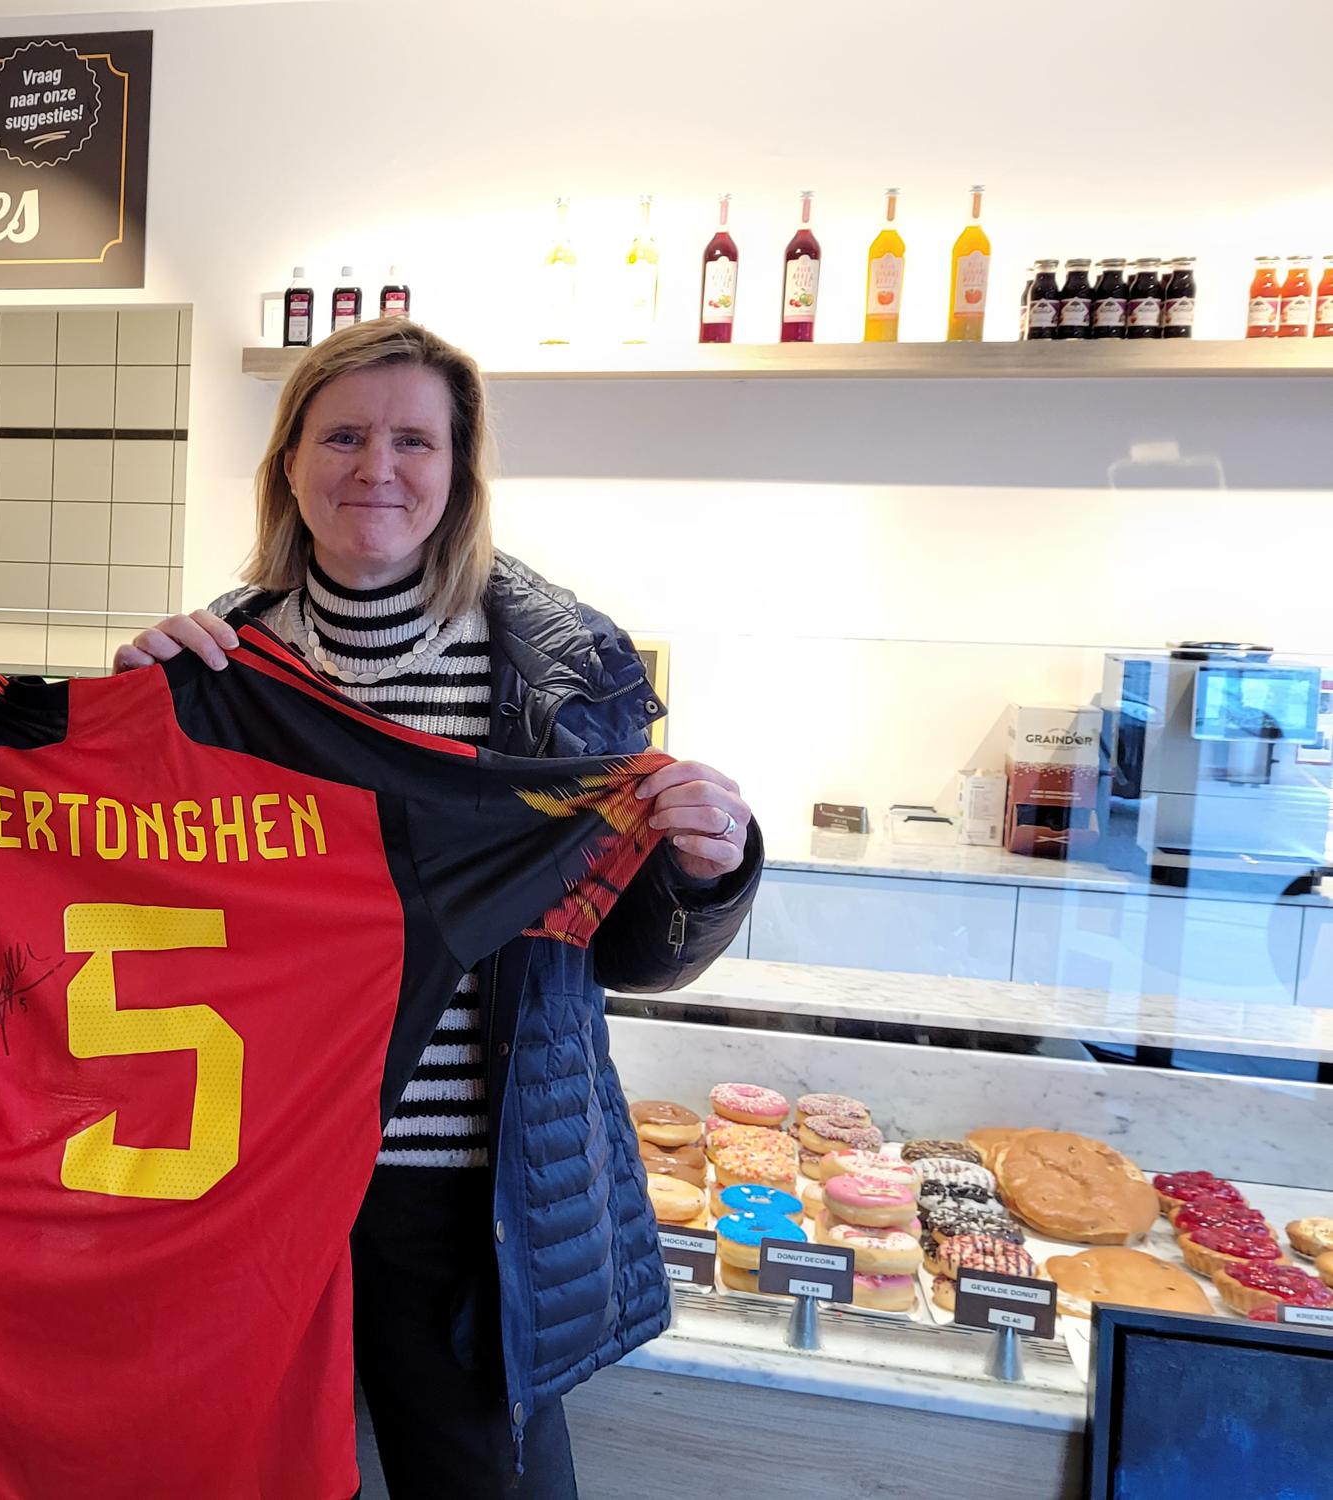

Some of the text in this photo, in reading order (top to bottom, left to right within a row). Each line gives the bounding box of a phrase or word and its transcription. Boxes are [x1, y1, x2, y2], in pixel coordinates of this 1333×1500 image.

[22, 68, 62, 86] Vraag
[9, 87, 77, 109] naar onze
[4, 103, 84, 132] suggesties!
[61, 902, 245, 1202] 5
[777, 1252, 802, 1262] DONUT
[667, 1268, 682, 1276] 1.85
[970, 1282, 1039, 1299] GEVULDE DONUT
